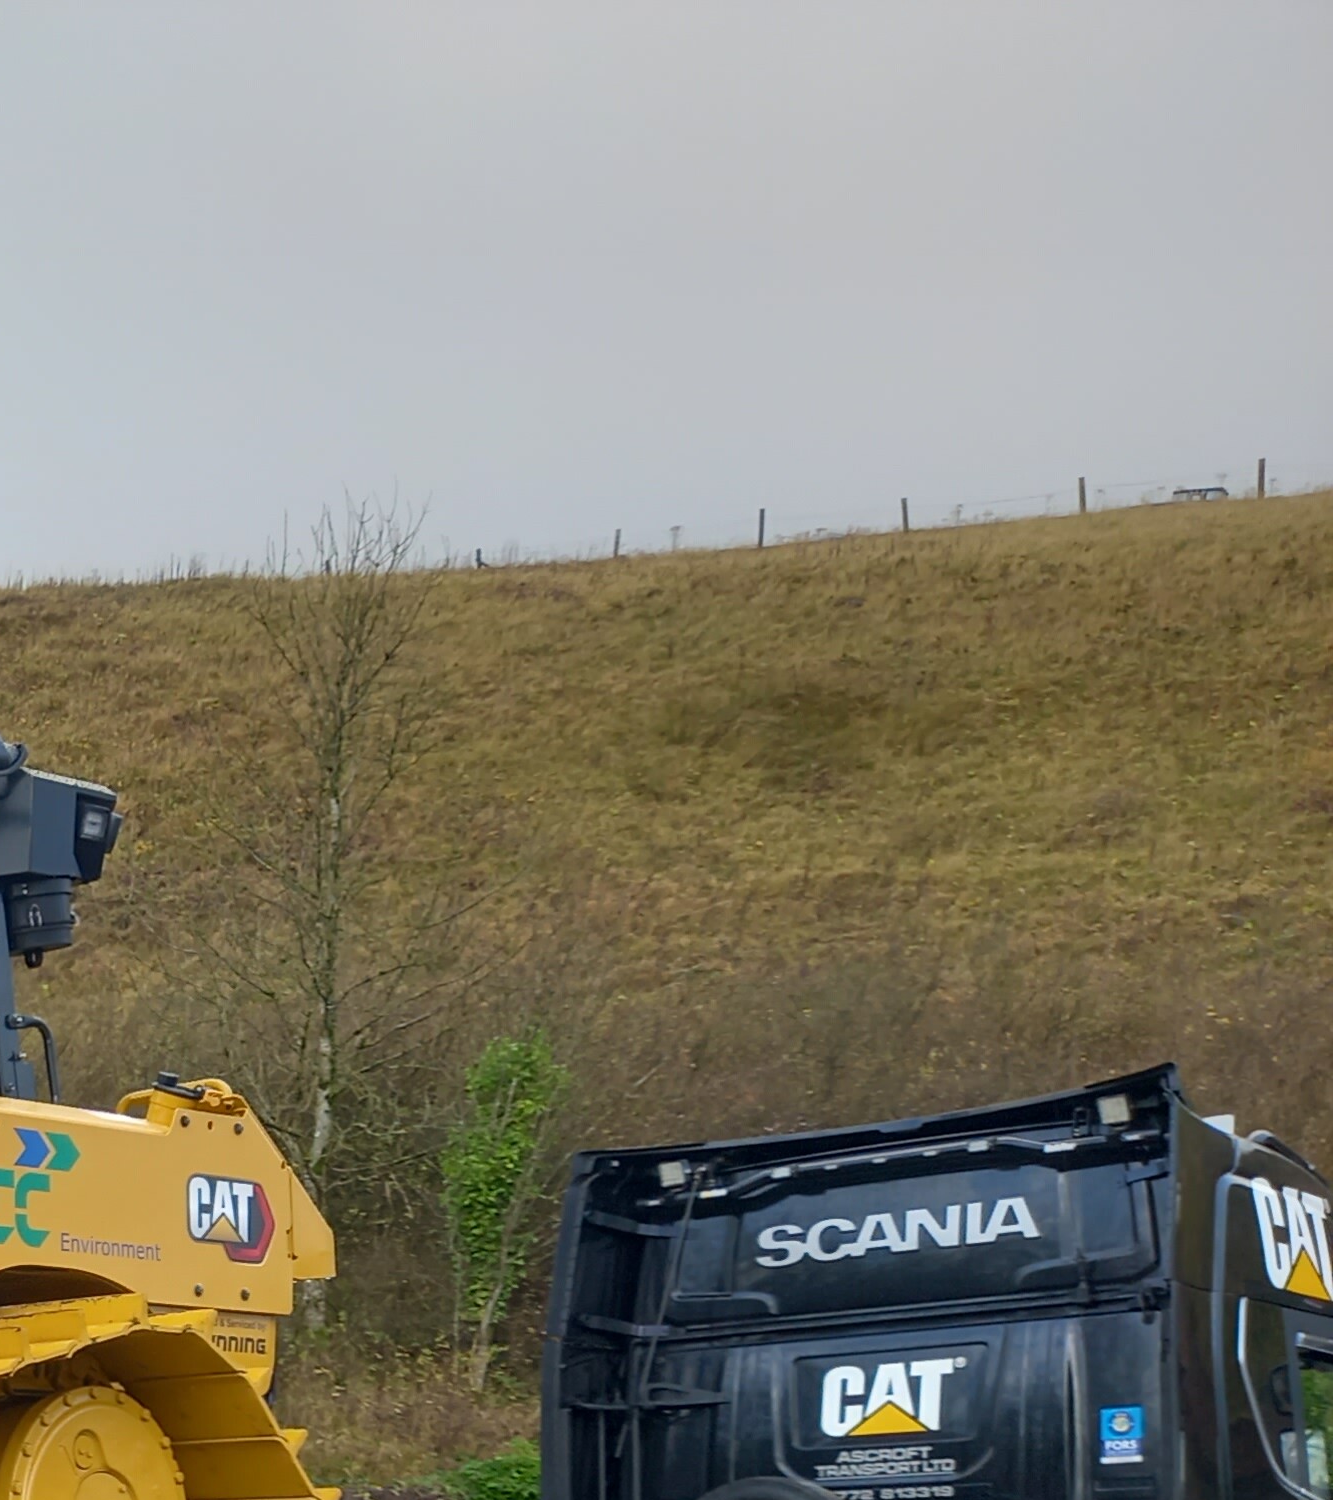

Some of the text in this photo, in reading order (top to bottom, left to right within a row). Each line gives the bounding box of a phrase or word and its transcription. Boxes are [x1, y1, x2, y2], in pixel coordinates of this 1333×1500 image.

[189, 1176, 254, 1243] CAT
[60, 1232, 162, 1262] Environment
[755, 1196, 1041, 1268] SCANIA
[1251, 1177, 1333, 1302] CAT
[212, 1334, 267, 1355] NNING
[820, 1357, 955, 1438] CAT
[835, 1446, 933, 1463] ASCROFT
[1104, 1439, 1138, 1451] FORS
[814, 1458, 957, 1478] TRANSPORT LTD
